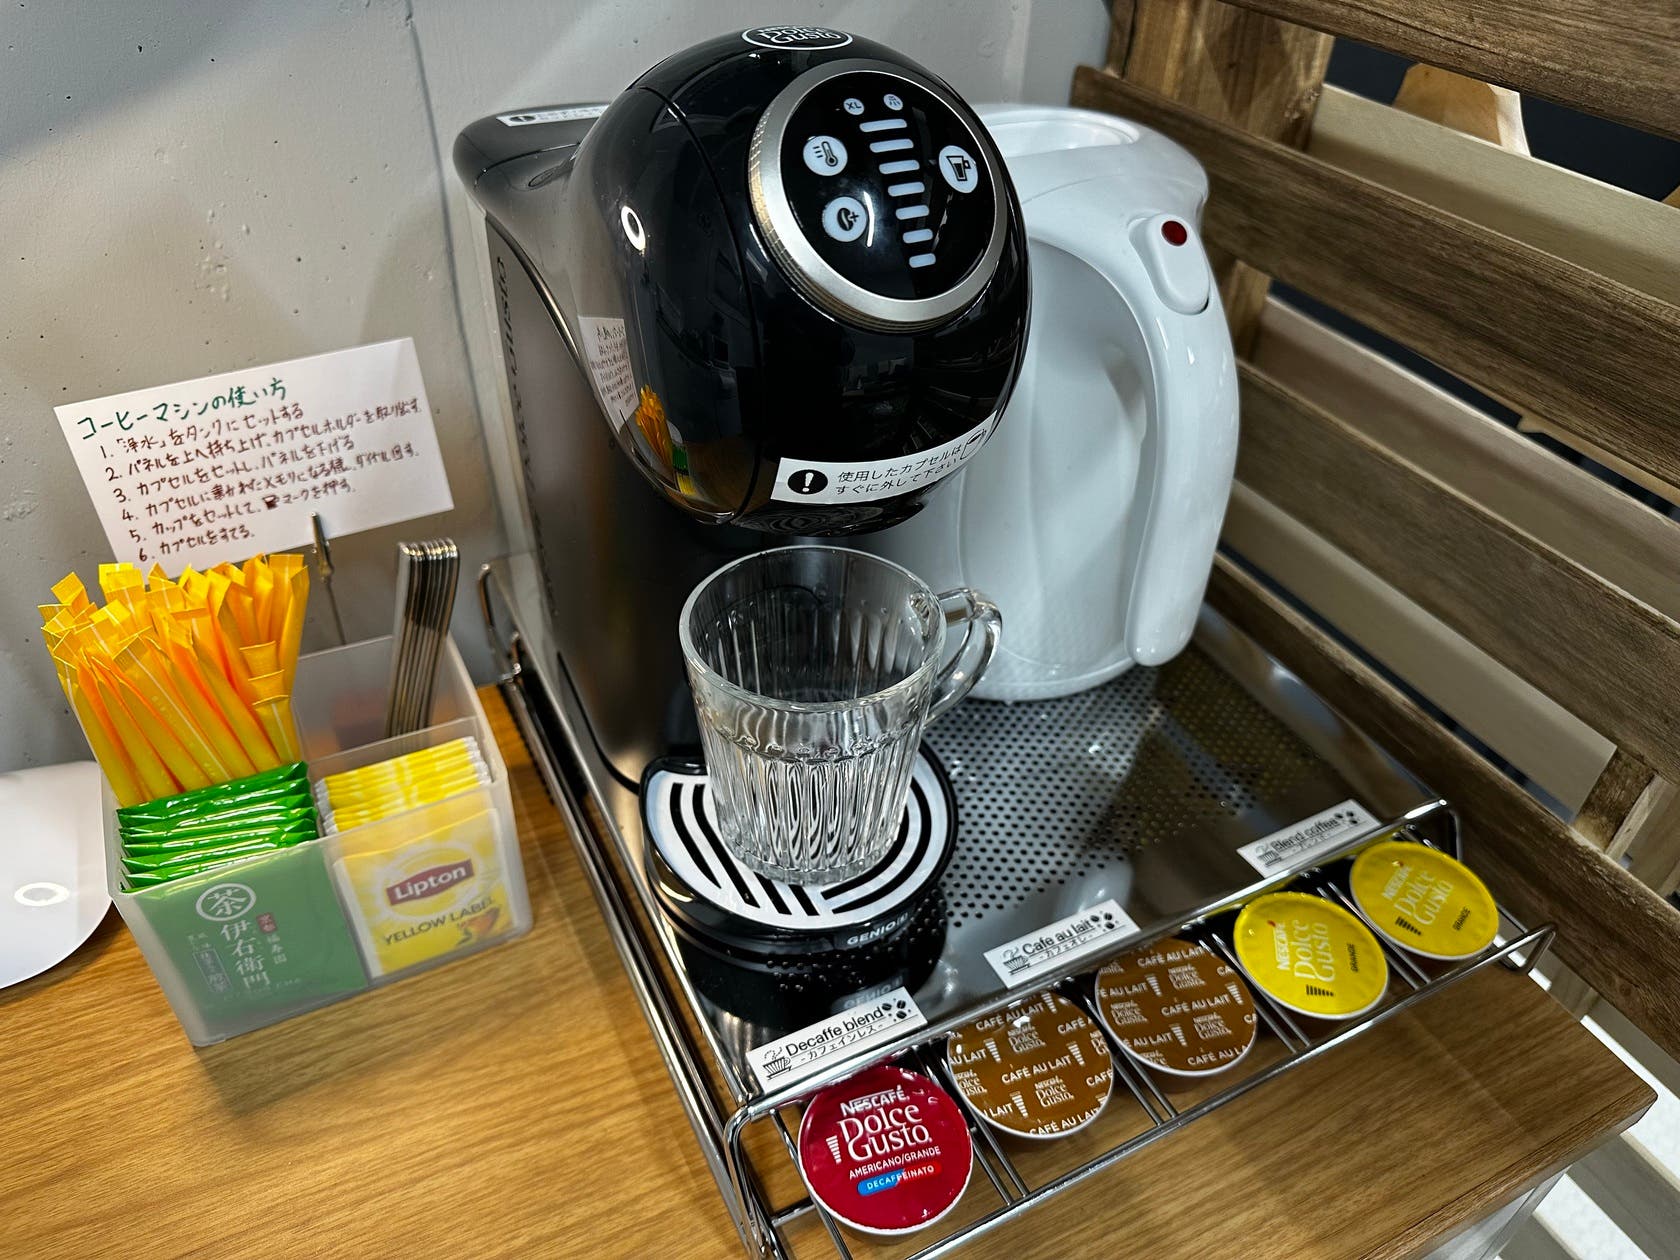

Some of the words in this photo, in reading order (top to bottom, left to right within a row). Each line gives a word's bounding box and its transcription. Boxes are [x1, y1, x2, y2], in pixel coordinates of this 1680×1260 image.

[846, 101, 862, 110] XL
[77, 377, 287, 440] コーヒーマシンの使い方
[105, 466, 123, 482] 2.
[835, 458, 958, 494] すぐに外して下さい
[838, 444, 962, 483] 使用したカプセルは
[113, 488, 131, 503] 3.
[129, 529, 147, 543] 5.
[139, 547, 155, 562] 6.
[1270, 831, 1305, 852] Blend
[393, 865, 467, 899] Lipton
[383, 915, 446, 945] YELLOW
[450, 896, 493, 921] LABEL
[220, 920, 271, 989] 伊右衛門
[1022, 937, 1055, 956] Cafe
[1055, 928, 1072, 942] au
[1071, 920, 1093, 935] lait
[1290, 920, 1317, 979] Dolce
[1312, 922, 1336, 982] Gusto
[1191, 1000, 1207, 1011] AU
[1207, 994, 1231, 1008] LAIT
[785, 1024, 843, 1057] Decaffe
[843, 1006, 884, 1032] blend
[1149, 1031, 1173, 1045] LAIT
[963, 1048, 987, 1063] LAIT
[1001, 1065, 1032, 1084] CAFÉ
[1032, 1062, 1048, 1075] AU
[1048, 1054, 1072, 1069] LAIT
[1218, 1048, 1234, 1060] AU
[840, 1084, 909, 1117] NESCAFÉ
[837, 1103, 923, 1142] Dolce
[1061, 1116, 1077, 1129] AU
[847, 1124, 930, 1162] Gusto
[849, 1145, 942, 1180] AMERICANO/GRANDE
[866, 1165, 935, 1190] DECAFFEINATO
